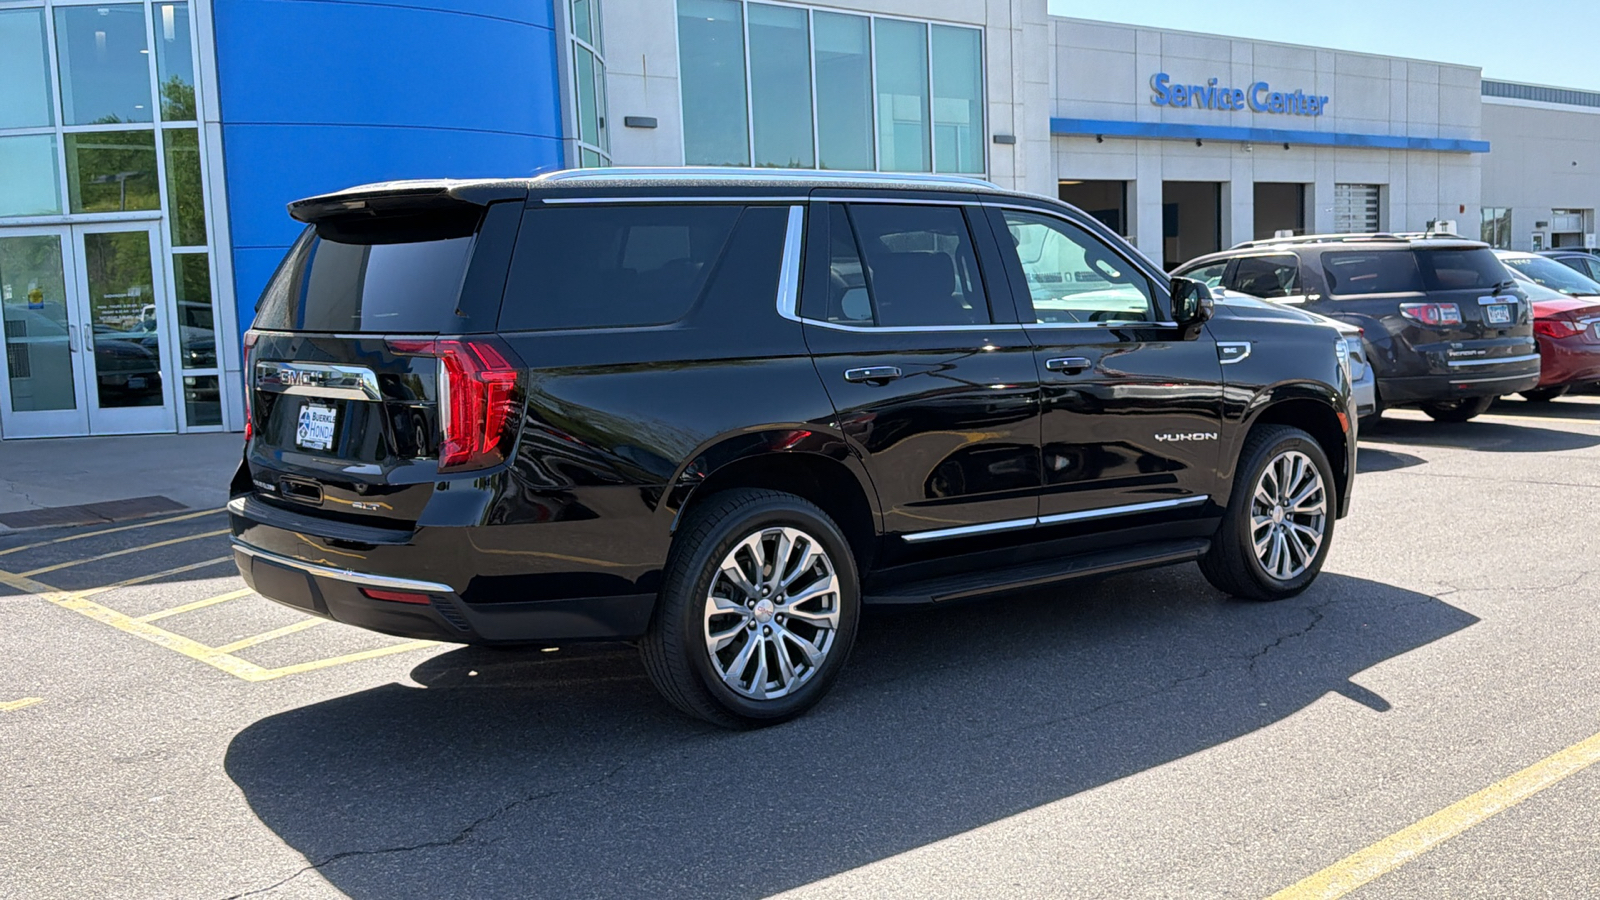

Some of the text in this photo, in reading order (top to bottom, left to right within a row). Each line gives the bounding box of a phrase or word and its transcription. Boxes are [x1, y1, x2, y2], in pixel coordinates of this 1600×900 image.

[1150, 73, 1329, 116] Service Center
[281, 369, 314, 386] GMC
[312, 411, 336, 423] BUERKLE
[310, 421, 334, 439] HONDA
[1154, 432, 1218, 442] YUKON
[352, 501, 380, 511] SLT
[757, 605, 773, 617] GMC
